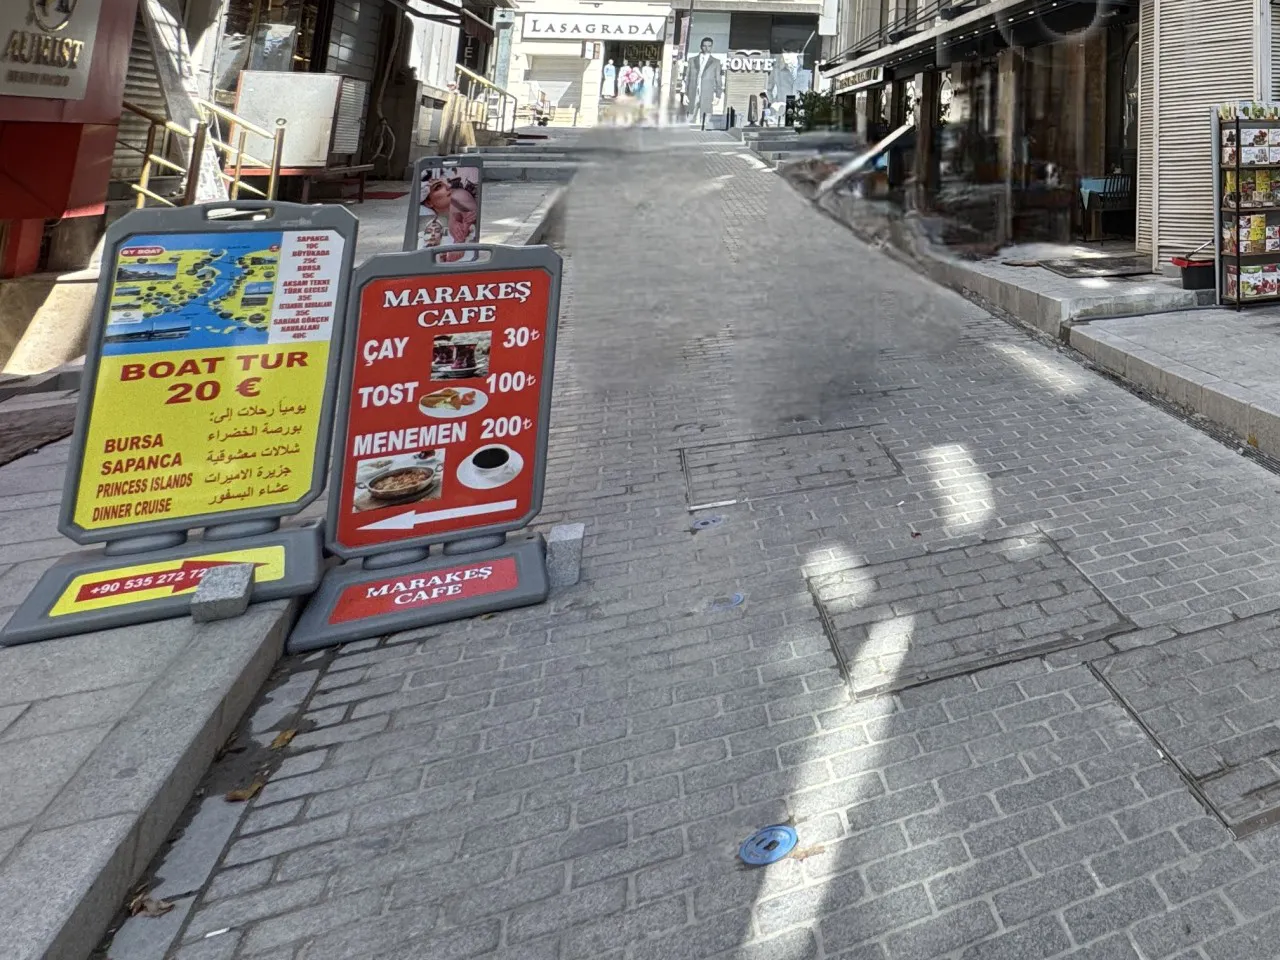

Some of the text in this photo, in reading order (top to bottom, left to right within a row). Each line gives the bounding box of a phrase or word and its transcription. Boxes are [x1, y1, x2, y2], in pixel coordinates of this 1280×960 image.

[531, 19, 656, 36] LASAGRADA
[720, 57, 774, 72] FONTE
[383, 280, 532, 308] MARAKEŞ
[417, 305, 497, 328] CAFE
[363, 337, 410, 367] ÇAY
[120, 351, 309, 382] BOAT TUR
[164, 377, 264, 405] 20 €
[358, 381, 420, 409] TOST
[103, 433, 164, 454] BURSA
[353, 421, 467, 457] MENEMEN
[101, 452, 183, 476] SAPANCA
[96, 473, 193, 499] PRINCESS ISLANDS
[92, 498, 172, 522] DINNER CRUISE
[89, 580, 121, 596] +90
[123, 576, 155, 591] 535
[157, 571, 186, 587] 272
[366, 565, 493, 598] MARAKEŞ
[394, 583, 463, 605] CAFE
